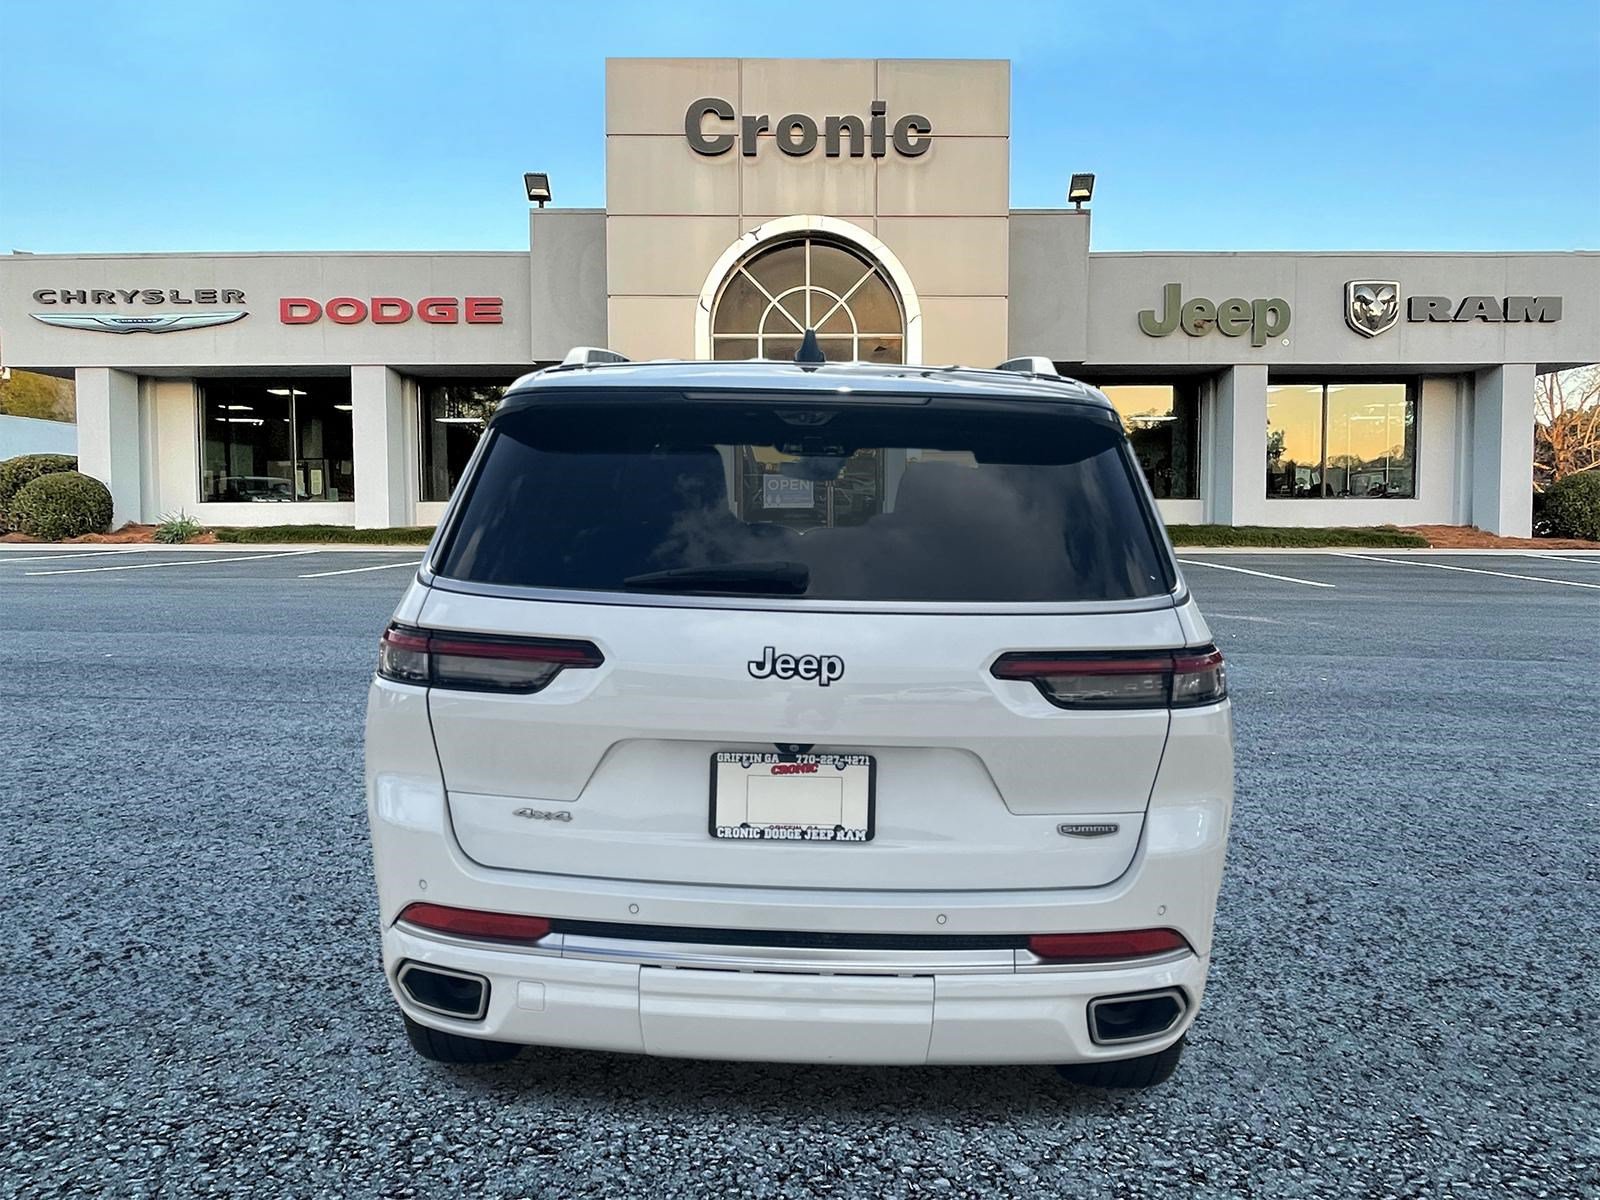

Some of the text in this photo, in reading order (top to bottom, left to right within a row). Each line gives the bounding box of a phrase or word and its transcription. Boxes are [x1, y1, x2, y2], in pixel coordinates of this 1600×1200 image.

[685, 97, 933, 158] Cronic
[32, 288, 247, 305] CHRYSLER
[279, 296, 504, 325] DODGE
[1138, 282, 1292, 348] Jeep
[1407, 295, 1563, 323] RAM
[767, 479, 810, 490] OPEN
[747, 646, 845, 687] Jeep
[717, 753, 779, 763] GRIFFIN GA
[796, 755, 870, 765] 770-227-4271
[771, 764, 819, 775] CRONIC
[717, 827, 865, 841] CRONIC DODGE JEEP RAM
